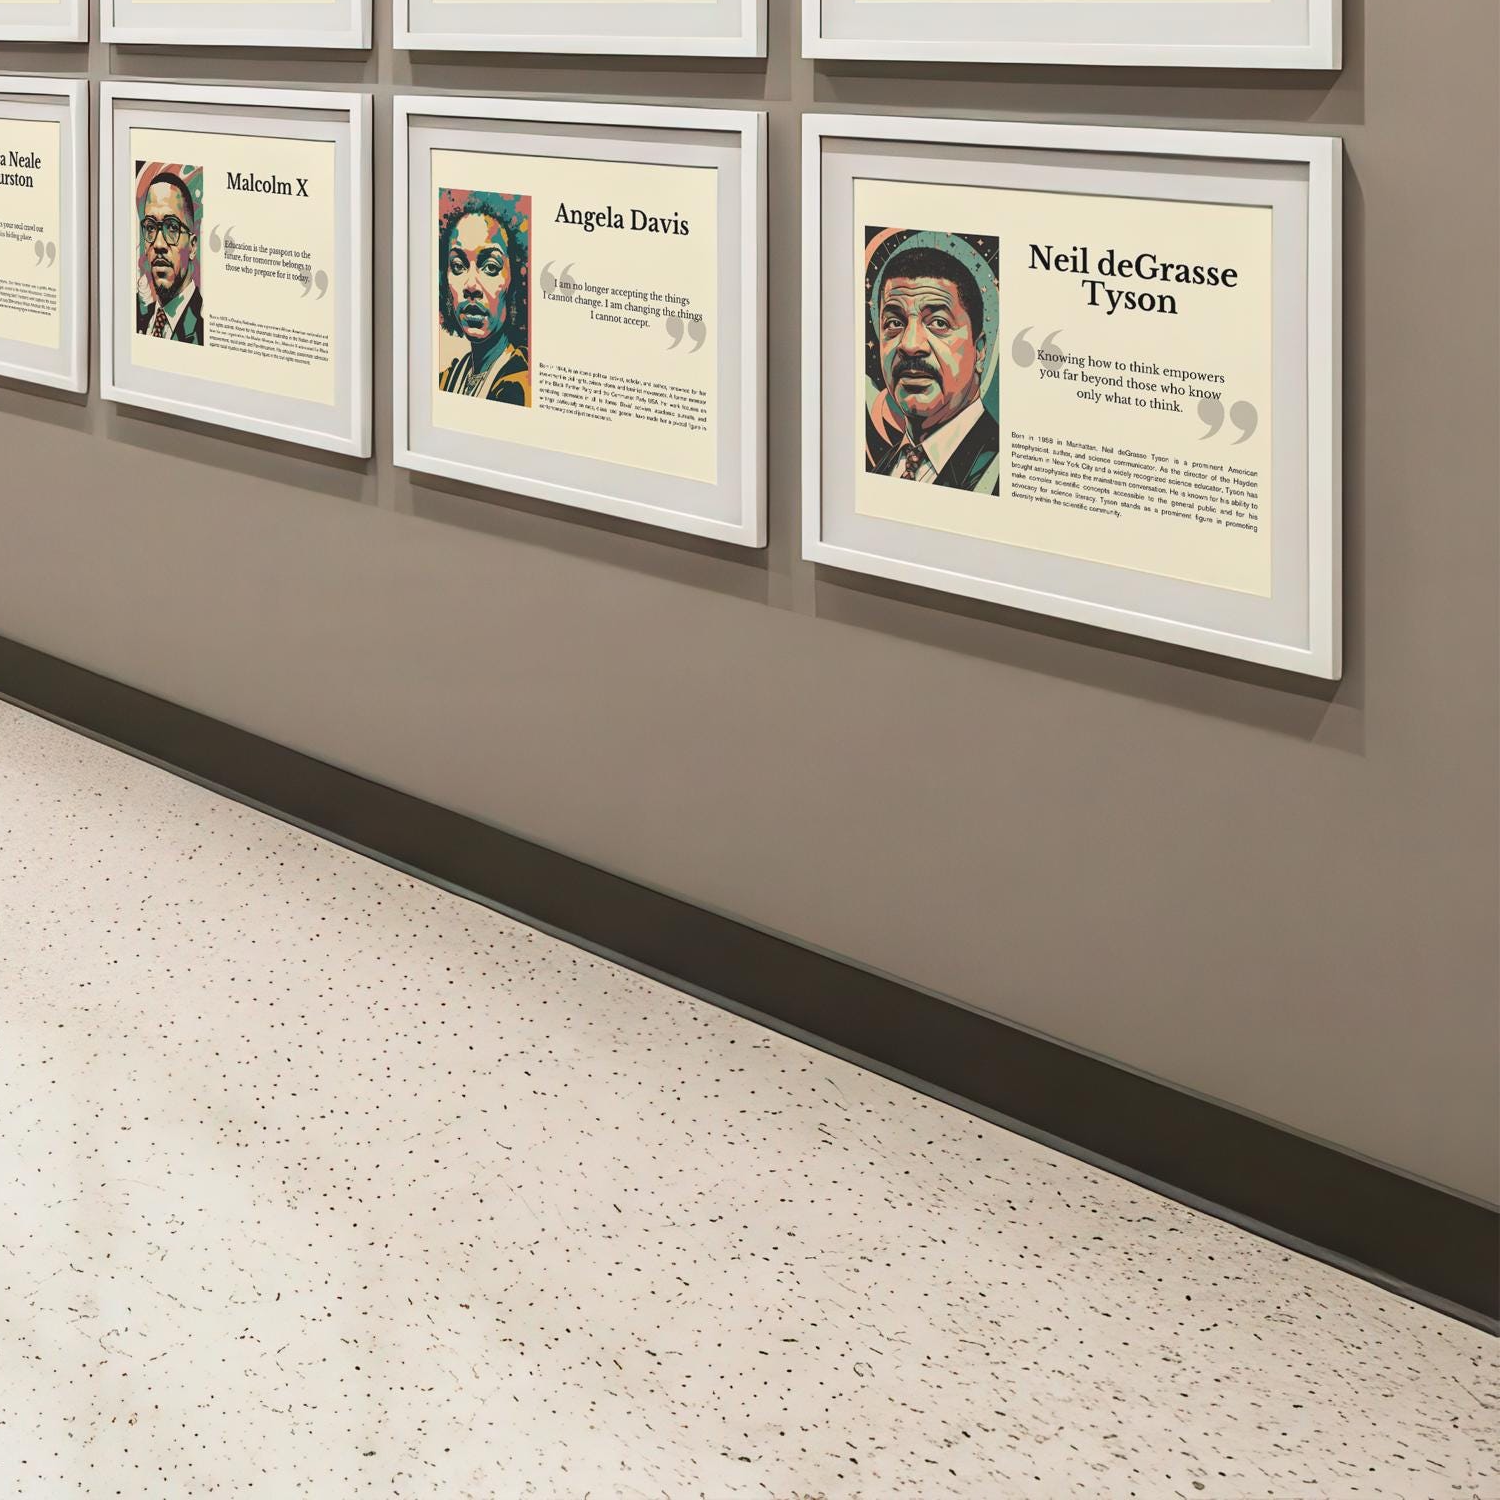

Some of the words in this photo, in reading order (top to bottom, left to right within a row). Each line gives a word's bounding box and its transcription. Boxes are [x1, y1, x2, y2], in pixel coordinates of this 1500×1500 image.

[9, 151, 41, 169] Neale
[227, 172, 292, 195] Malcolm
[296, 178, 308, 197] X
[554, 202, 624, 232] Angela
[630, 209, 689, 235] Davis
[243, 254, 252, 262] for
[252, 257, 281, 265] tomorrow
[282, 259, 304, 271] belongs
[1028, 244, 1089, 274] Neil
[1097, 249, 1237, 287] deGrasse
[1081, 279, 1178, 315] Tyson
[590, 310, 594, 319] I
[595, 313, 622, 323] cannot
[623, 317, 650, 328] accept.
[1037, 349, 1085, 368] Knowing
[1088, 355, 1111, 368] how
[1115, 361, 1126, 370] to
[1129, 361, 1159, 375] think
[1162, 368, 1225, 383] empowers
[1039, 368, 1060, 379] you
[1063, 368, 1078, 381] far
[1081, 370, 1123, 387] beyond
[1126, 377, 1157, 391] those
[1160, 382, 1185, 395] who
[1188, 385, 1221, 400] know
[1076, 389, 1102, 403] only
[1104, 392, 1131, 405] what
[1135, 397, 1146, 407] to
[1149, 397, 1183, 412] think.
